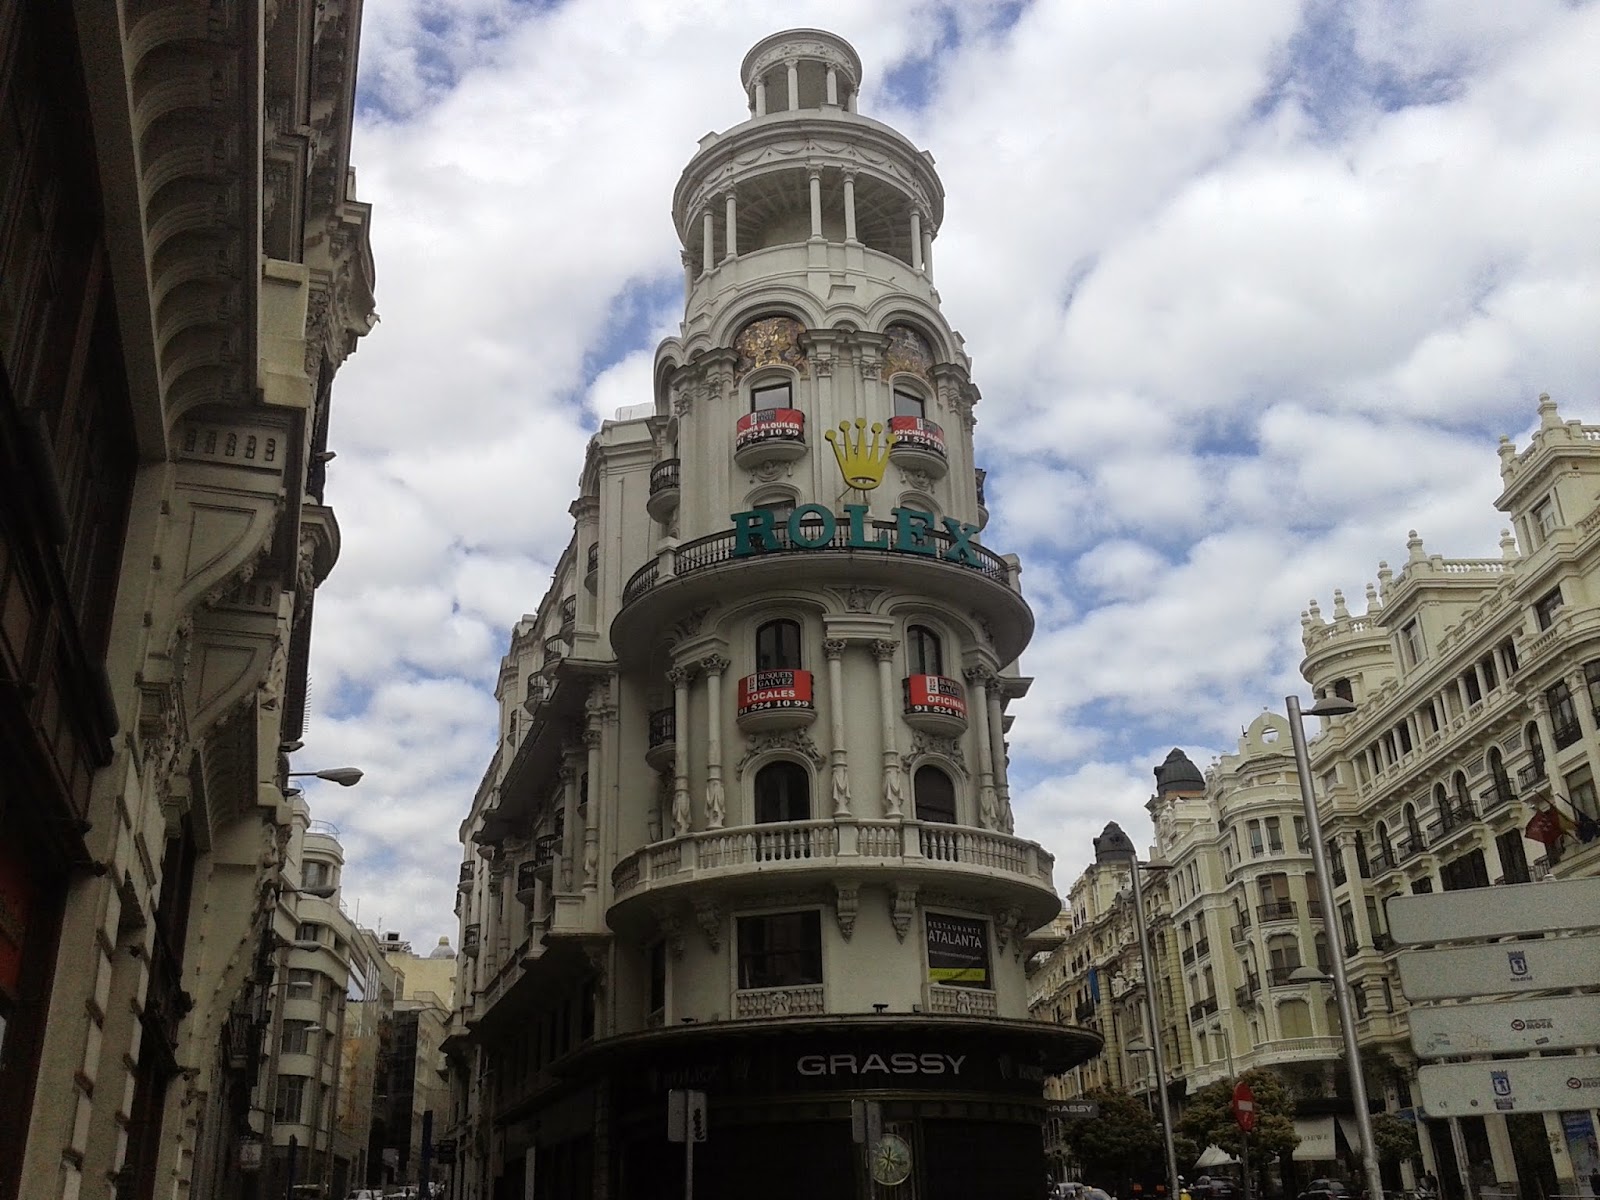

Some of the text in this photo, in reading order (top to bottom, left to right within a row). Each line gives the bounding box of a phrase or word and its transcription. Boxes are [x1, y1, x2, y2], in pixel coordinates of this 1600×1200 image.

[760, 421, 800, 430] ALQUILER
[747, 430, 765, 440] 524
[770, 428, 782, 436] 10
[785, 428, 799, 437] 99
[913, 437, 931, 446] 524
[731, 503, 984, 568] ROLEX
[758, 671, 793, 681] BUSQUETS
[758, 677, 793, 687] GALVEZ
[746, 689, 796, 704] LOCALES
[738, 706, 748, 715] 91
[751, 701, 772, 711] 524
[794, 700, 809, 708] 99
[914, 704, 929, 712] 91
[933, 705, 953, 715] 524
[928, 929, 982, 949] ATALANTA
[796, 1053, 966, 1076] GRASSY
